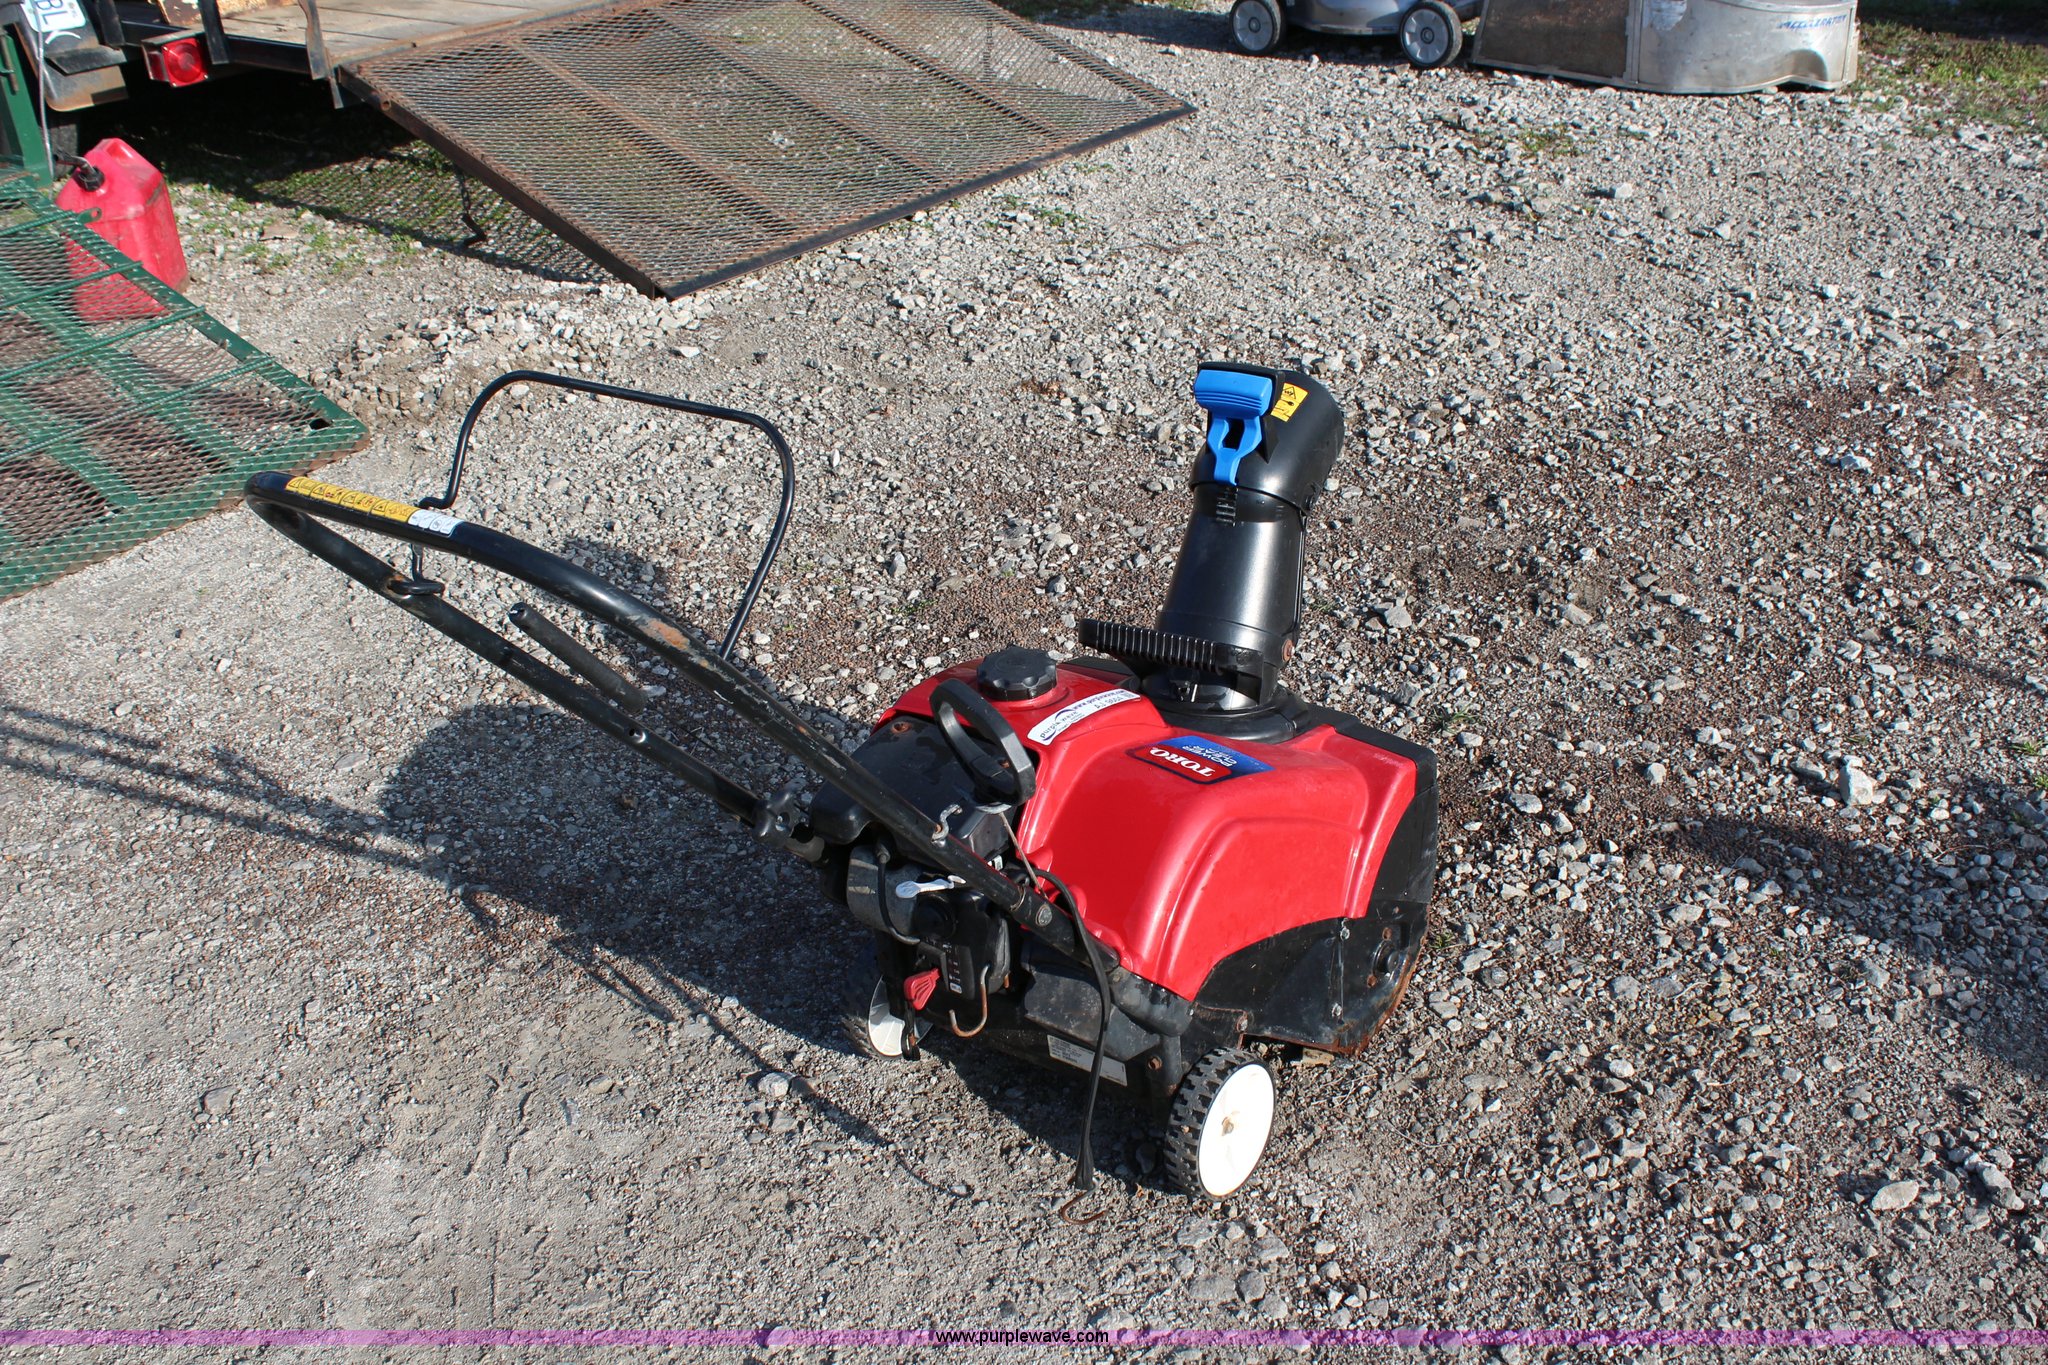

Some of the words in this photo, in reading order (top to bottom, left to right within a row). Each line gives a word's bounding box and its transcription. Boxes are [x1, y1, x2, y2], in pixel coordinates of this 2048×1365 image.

[1149, 746, 1216, 777] TORO
[1182, 744, 1233, 767] POWER
[1191, 744, 1238, 765] CLEAR
